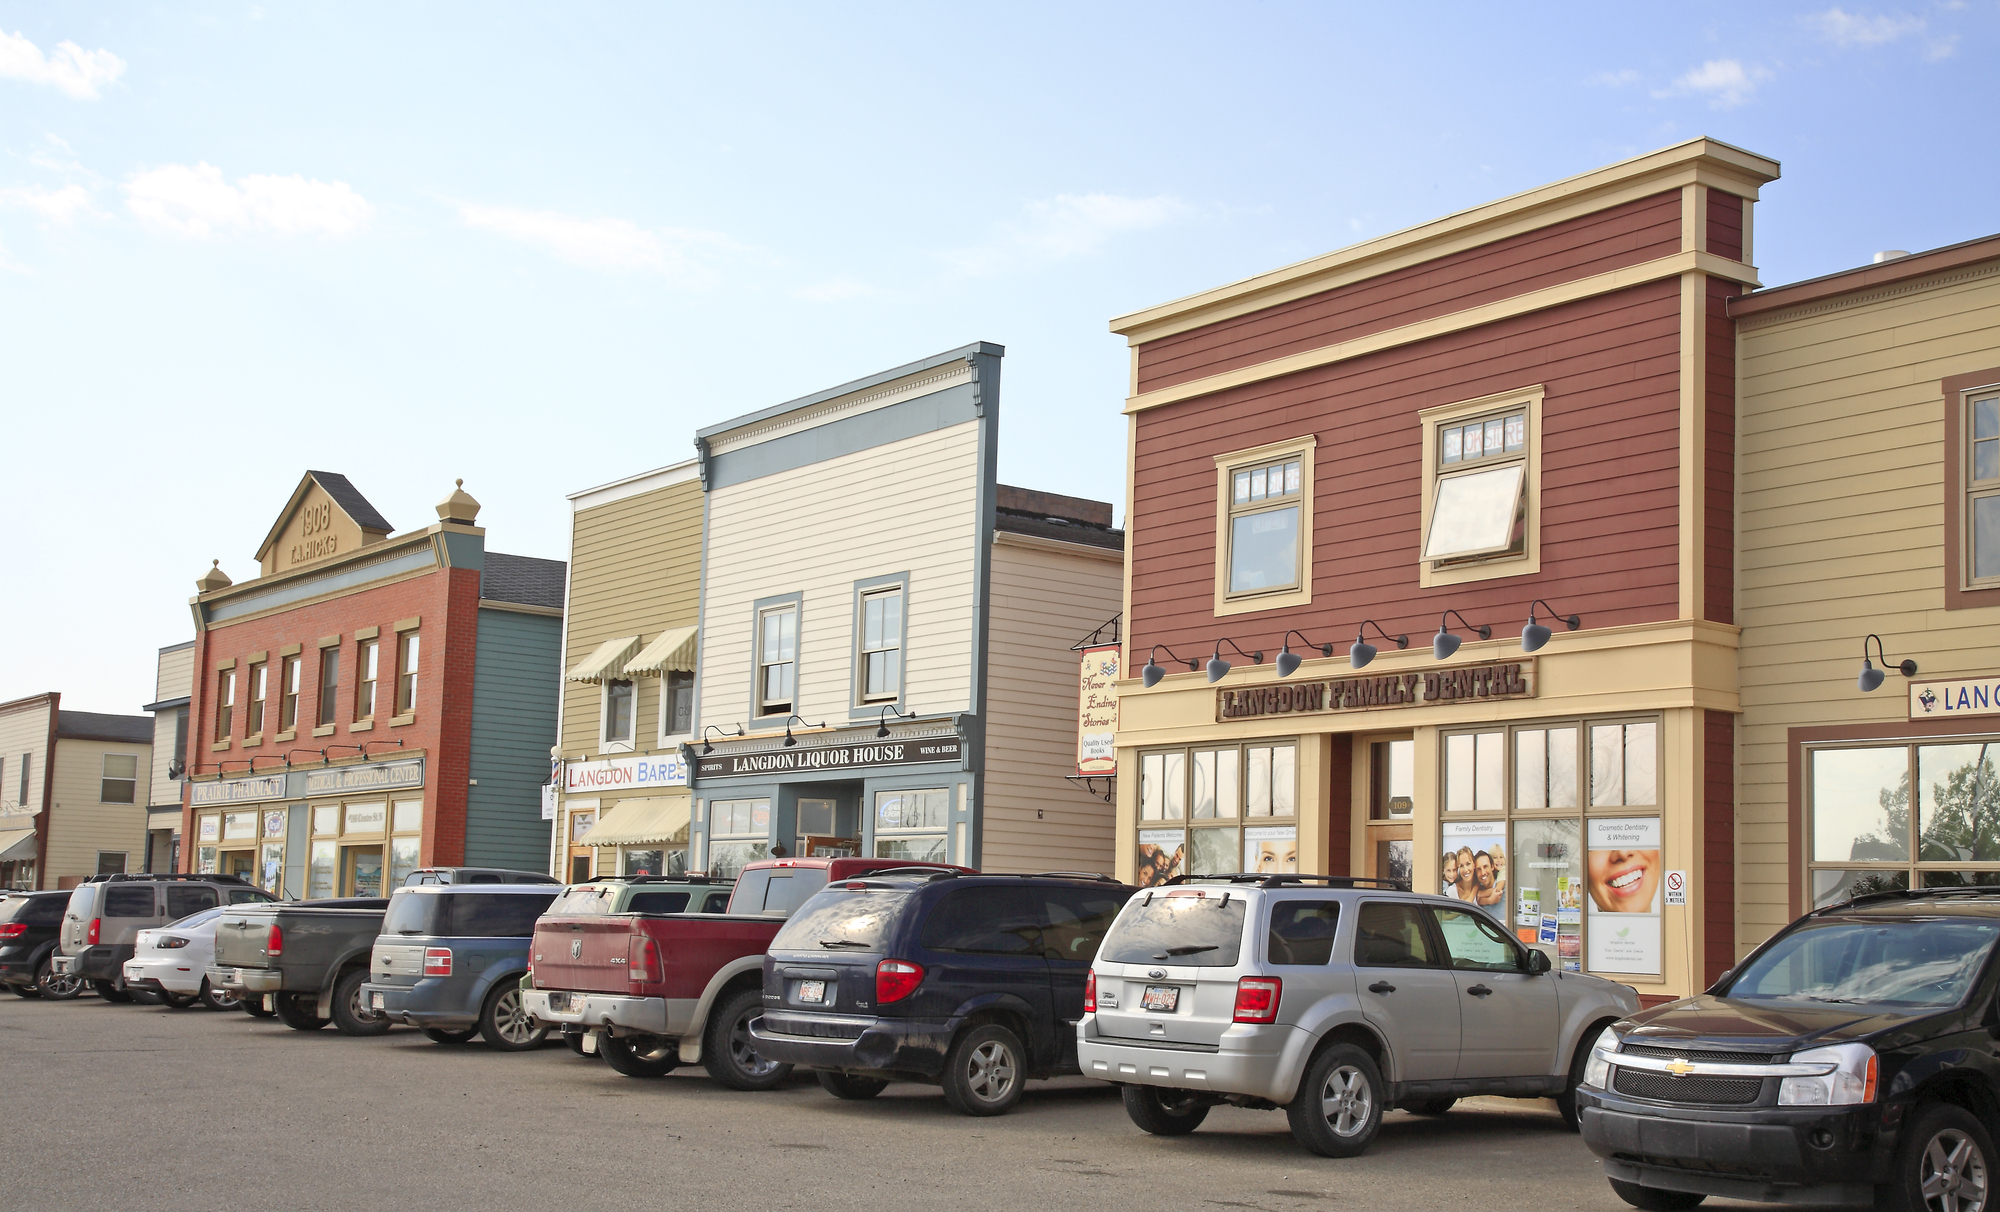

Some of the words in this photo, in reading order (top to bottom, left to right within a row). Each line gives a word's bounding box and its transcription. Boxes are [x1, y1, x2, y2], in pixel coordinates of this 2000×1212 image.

[301, 501, 330, 537] 1908
[1082, 673, 1106, 690] Never
[1223, 683, 1324, 717] LANGDON
[1329, 674, 1418, 708] FAMILY
[1424, 664, 1525, 700] DENTAL
[1087, 694, 1117, 709] Ending
[1082, 713, 1109, 727] Stories
[942, 745, 957, 753] BEER
[1083, 739, 1100, 747] Quality
[733, 754, 794, 772] LANGDON
[797, 749, 850, 768] LIQUOR
[853, 745, 904, 763] HOUSE
[701, 763, 722, 772] SPIRITS
[308, 774, 334, 790] MEDICAL
[336, 774, 342, 788] &
[344, 768, 388, 787] PROFESSIONAL
[390, 765, 419, 782] CENTER
[569, 766, 633, 787] LANGDON
[197, 784, 230, 801] PRAIRIE
[233, 779, 281, 799] PHARMACY
[1393, 802, 1407, 810] 109
